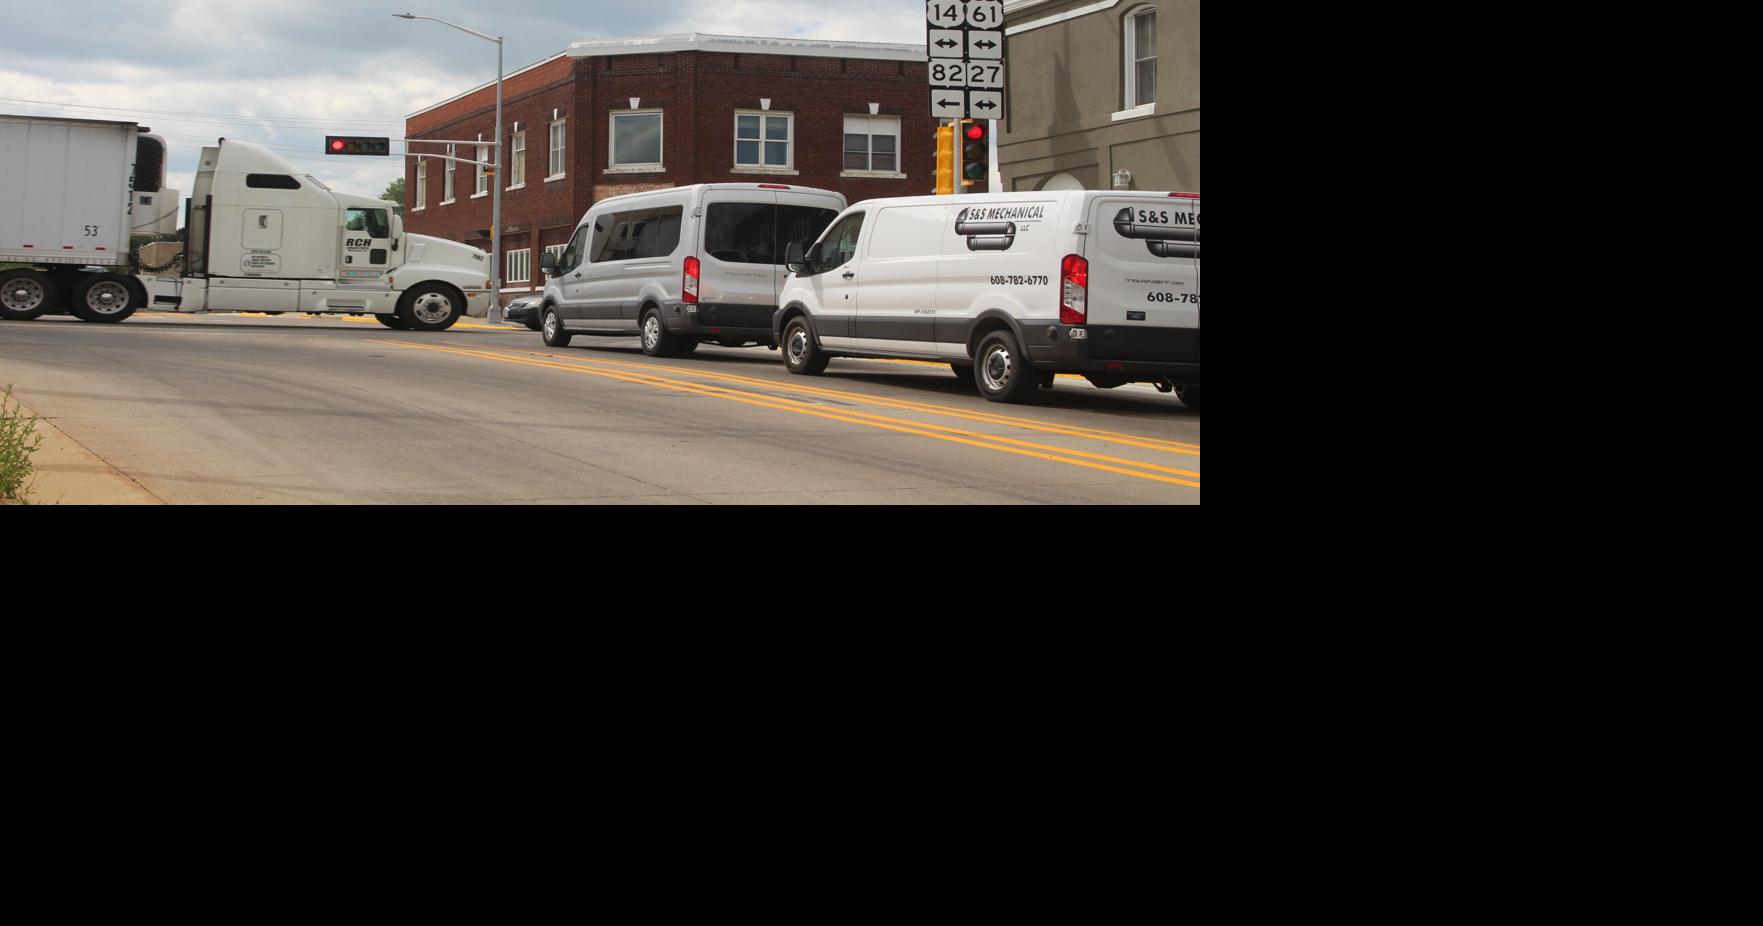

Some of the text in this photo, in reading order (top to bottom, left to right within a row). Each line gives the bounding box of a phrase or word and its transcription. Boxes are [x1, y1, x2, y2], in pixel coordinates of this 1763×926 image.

[934, 4, 957, 21] 14
[973, 6, 996, 22] 61
[932, 64, 962, 81] 82
[971, 65, 999, 83] 27
[969, 206, 1044, 220] S&S MECHANICAL
[1139, 210, 1200, 225] S&S ME
[346, 238, 372, 246] RCH
[990, 275, 1048, 285] 608-782-6770
[1147, 292, 1200, 303] 608-78
